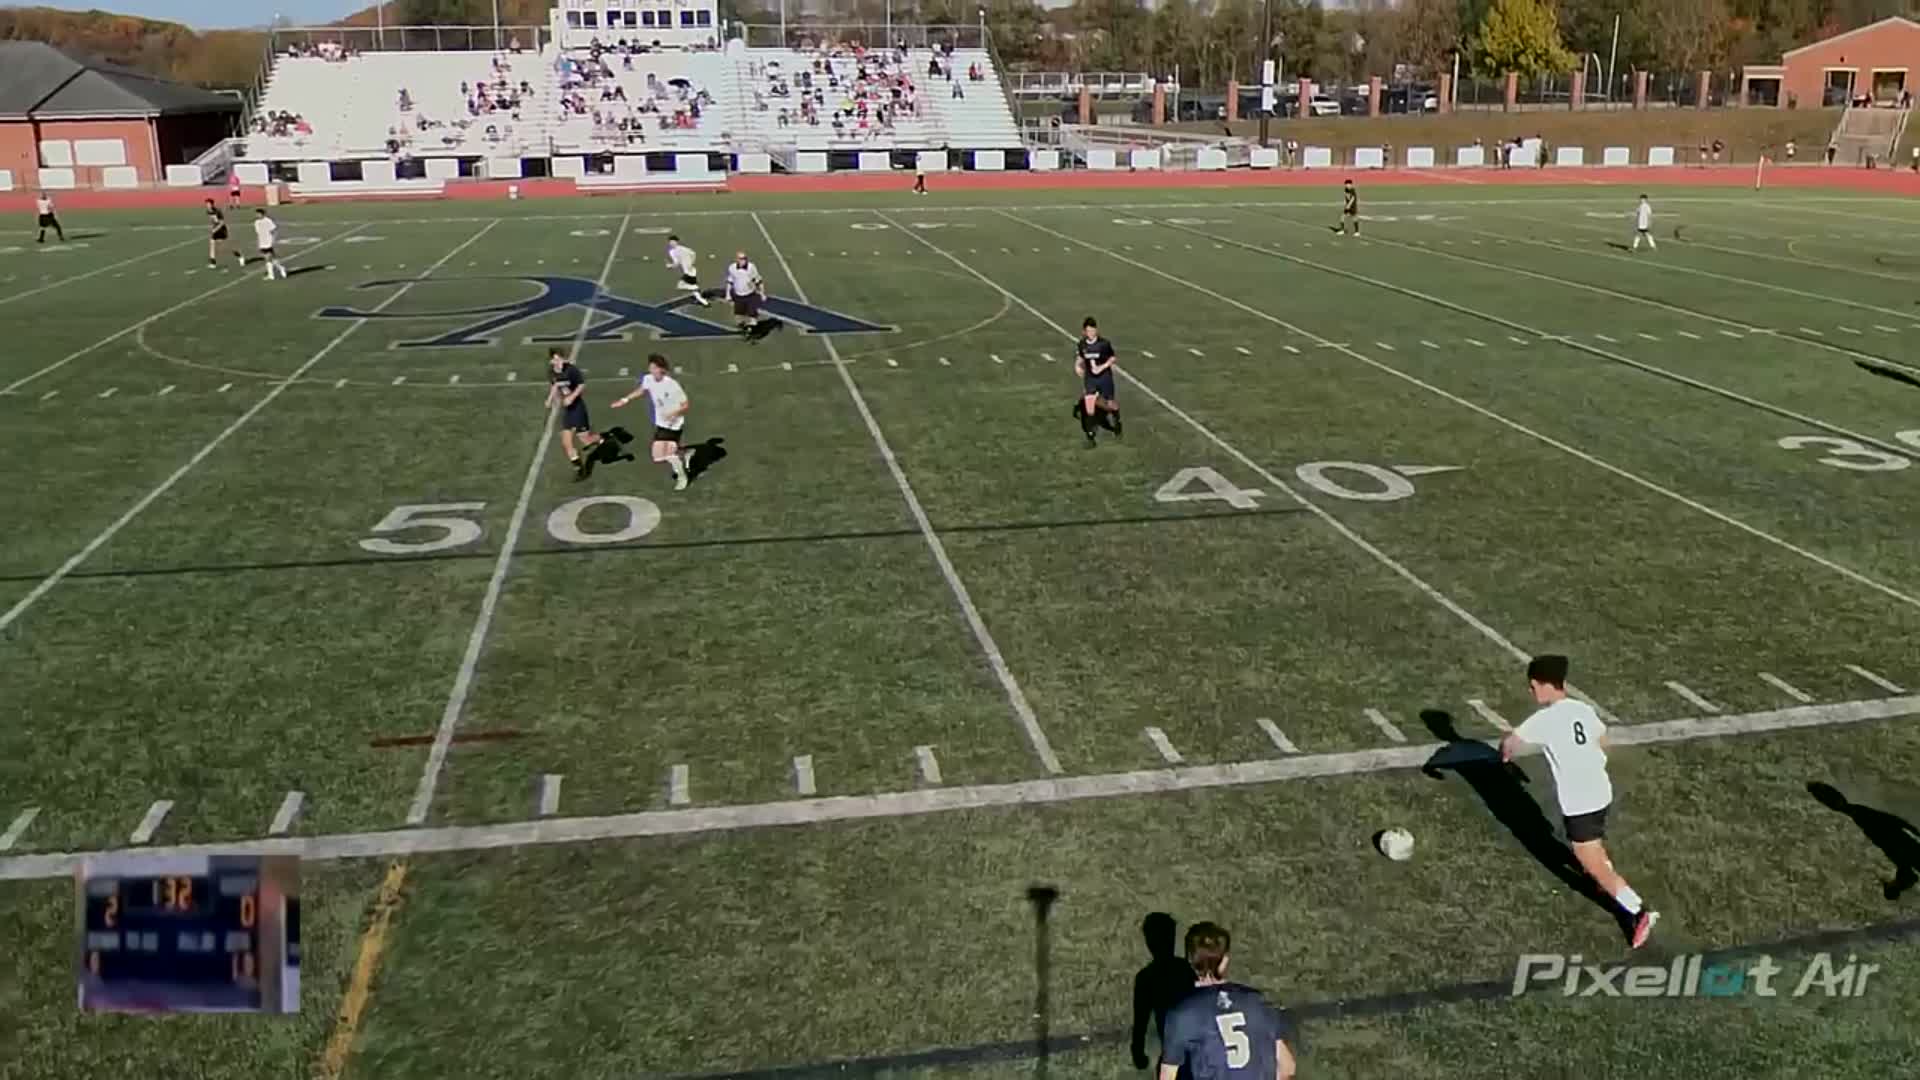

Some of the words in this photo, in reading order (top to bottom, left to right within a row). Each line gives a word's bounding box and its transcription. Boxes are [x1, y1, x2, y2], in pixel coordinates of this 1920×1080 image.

[1154, 461, 1416, 509] 40
[358, 495, 662, 553] 50
[1573, 721, 1587, 745] 8
[1216, 1011, 1250, 1069] 5
